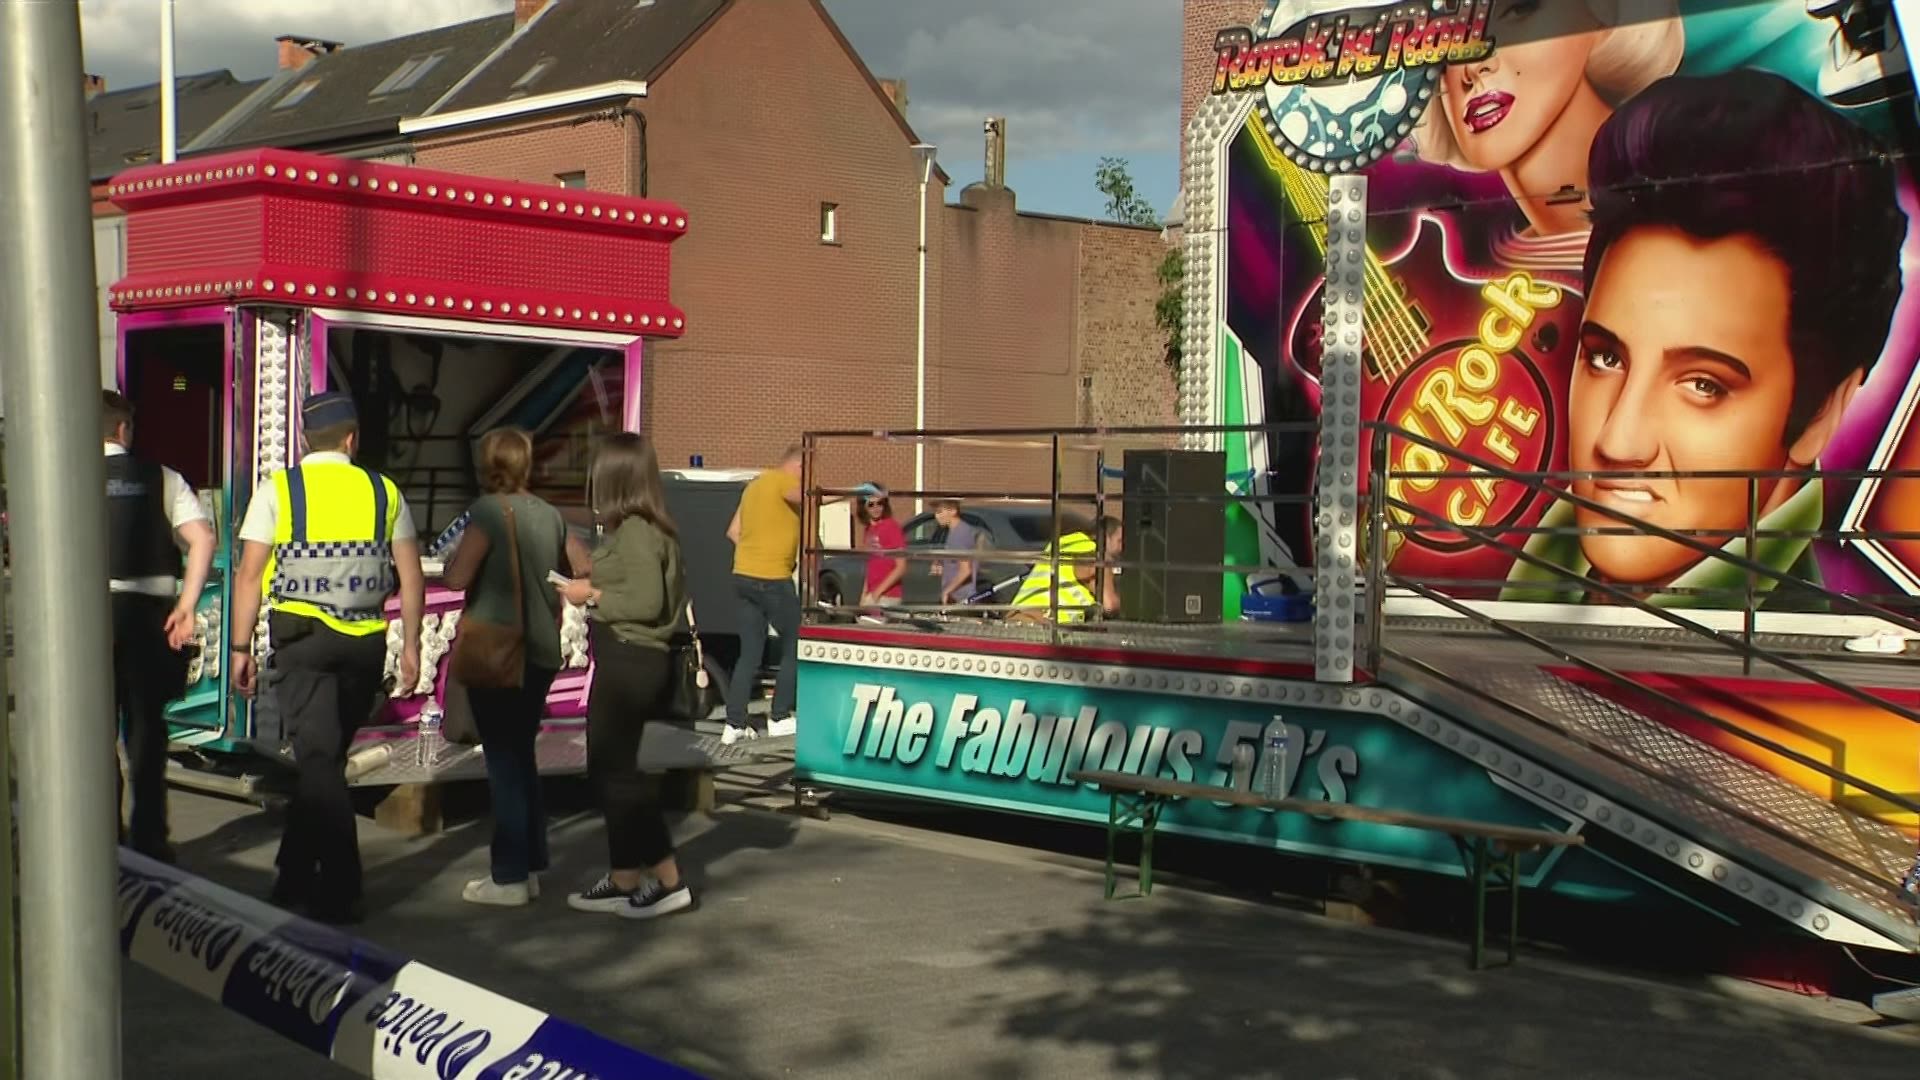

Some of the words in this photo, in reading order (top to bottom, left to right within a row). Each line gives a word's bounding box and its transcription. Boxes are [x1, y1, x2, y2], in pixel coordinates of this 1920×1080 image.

[1447, 395, 1540, 530] CAFE
[841, 682, 935, 766] The
[935, 692, 1203, 800] Fabulous
[366, 991, 464, 1066] Police
